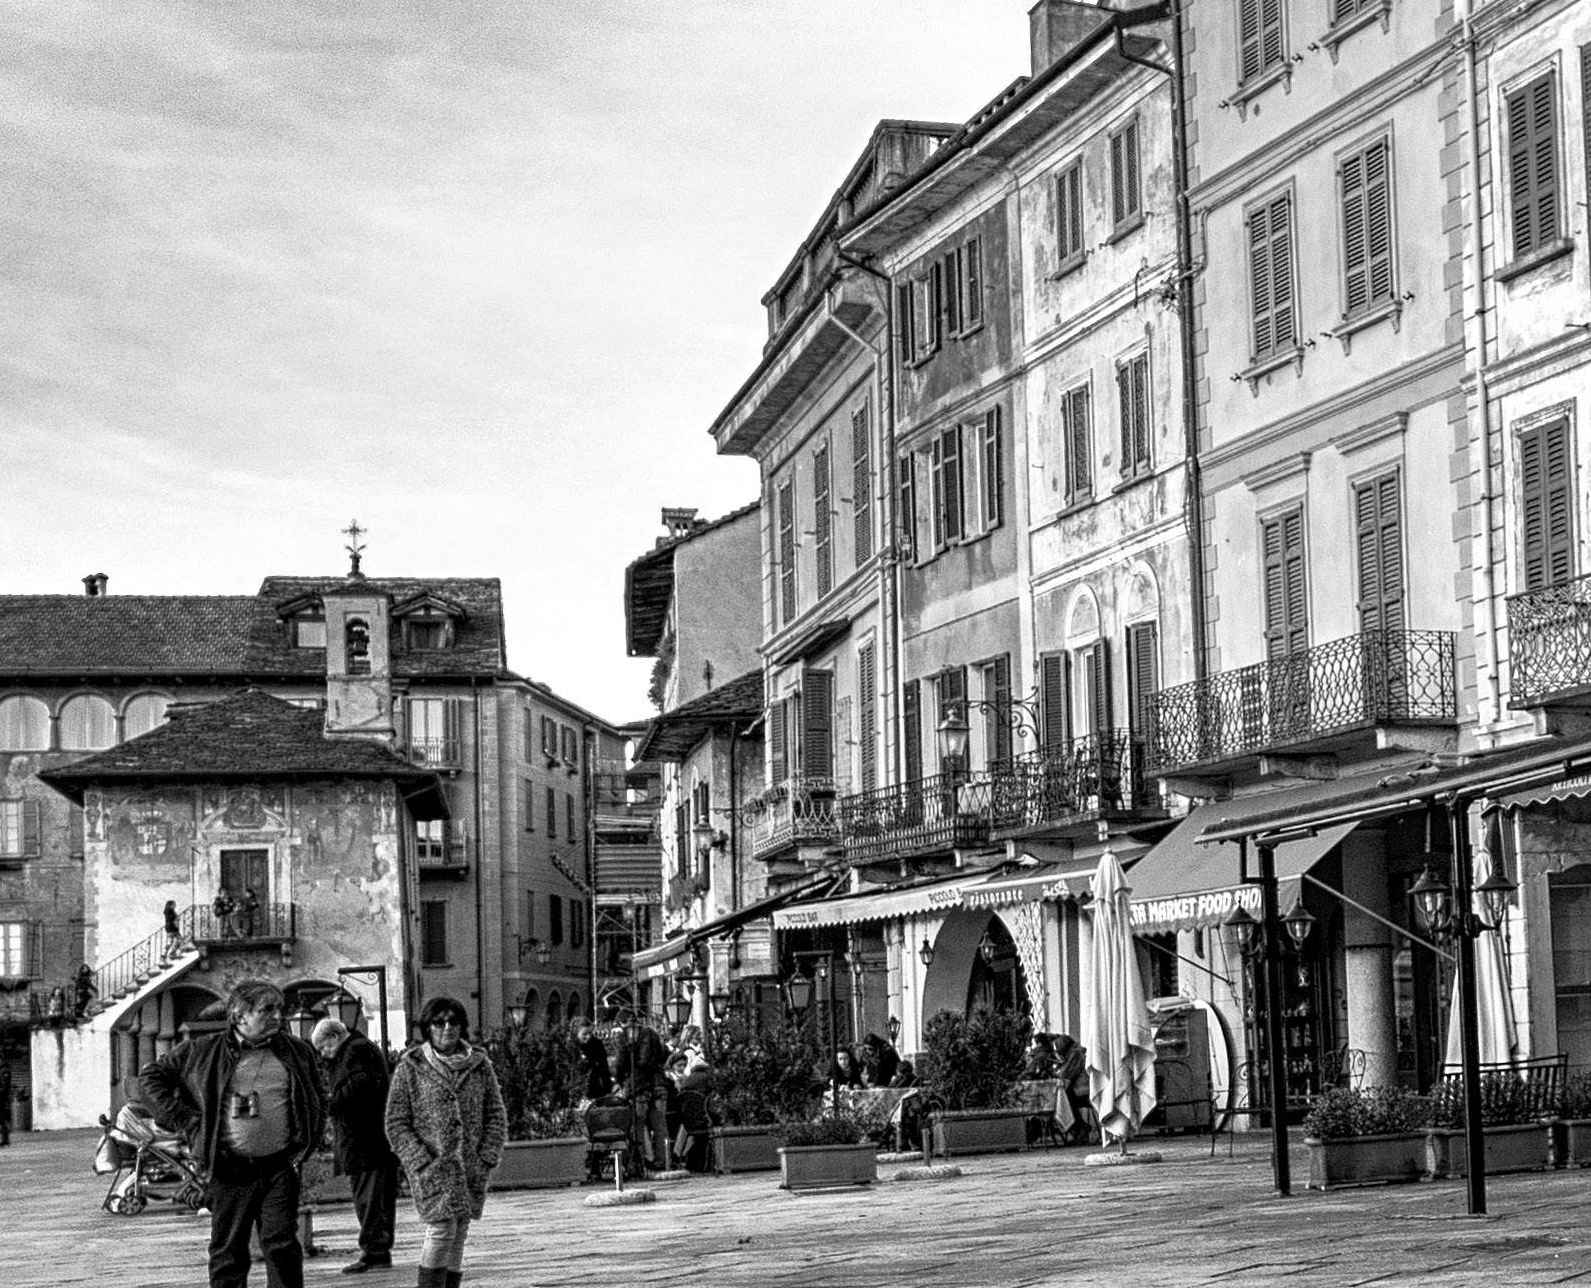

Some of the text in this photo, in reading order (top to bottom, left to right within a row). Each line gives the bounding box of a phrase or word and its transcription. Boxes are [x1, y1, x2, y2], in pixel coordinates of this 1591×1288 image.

[928, 888, 955, 904] PICCOLO
[969, 889, 1023, 906] ristorante
[1147, 897, 1196, 923] MARKET
[1197, 891, 1231, 918] FOOD
[1233, 887, 1262, 909] SHO
